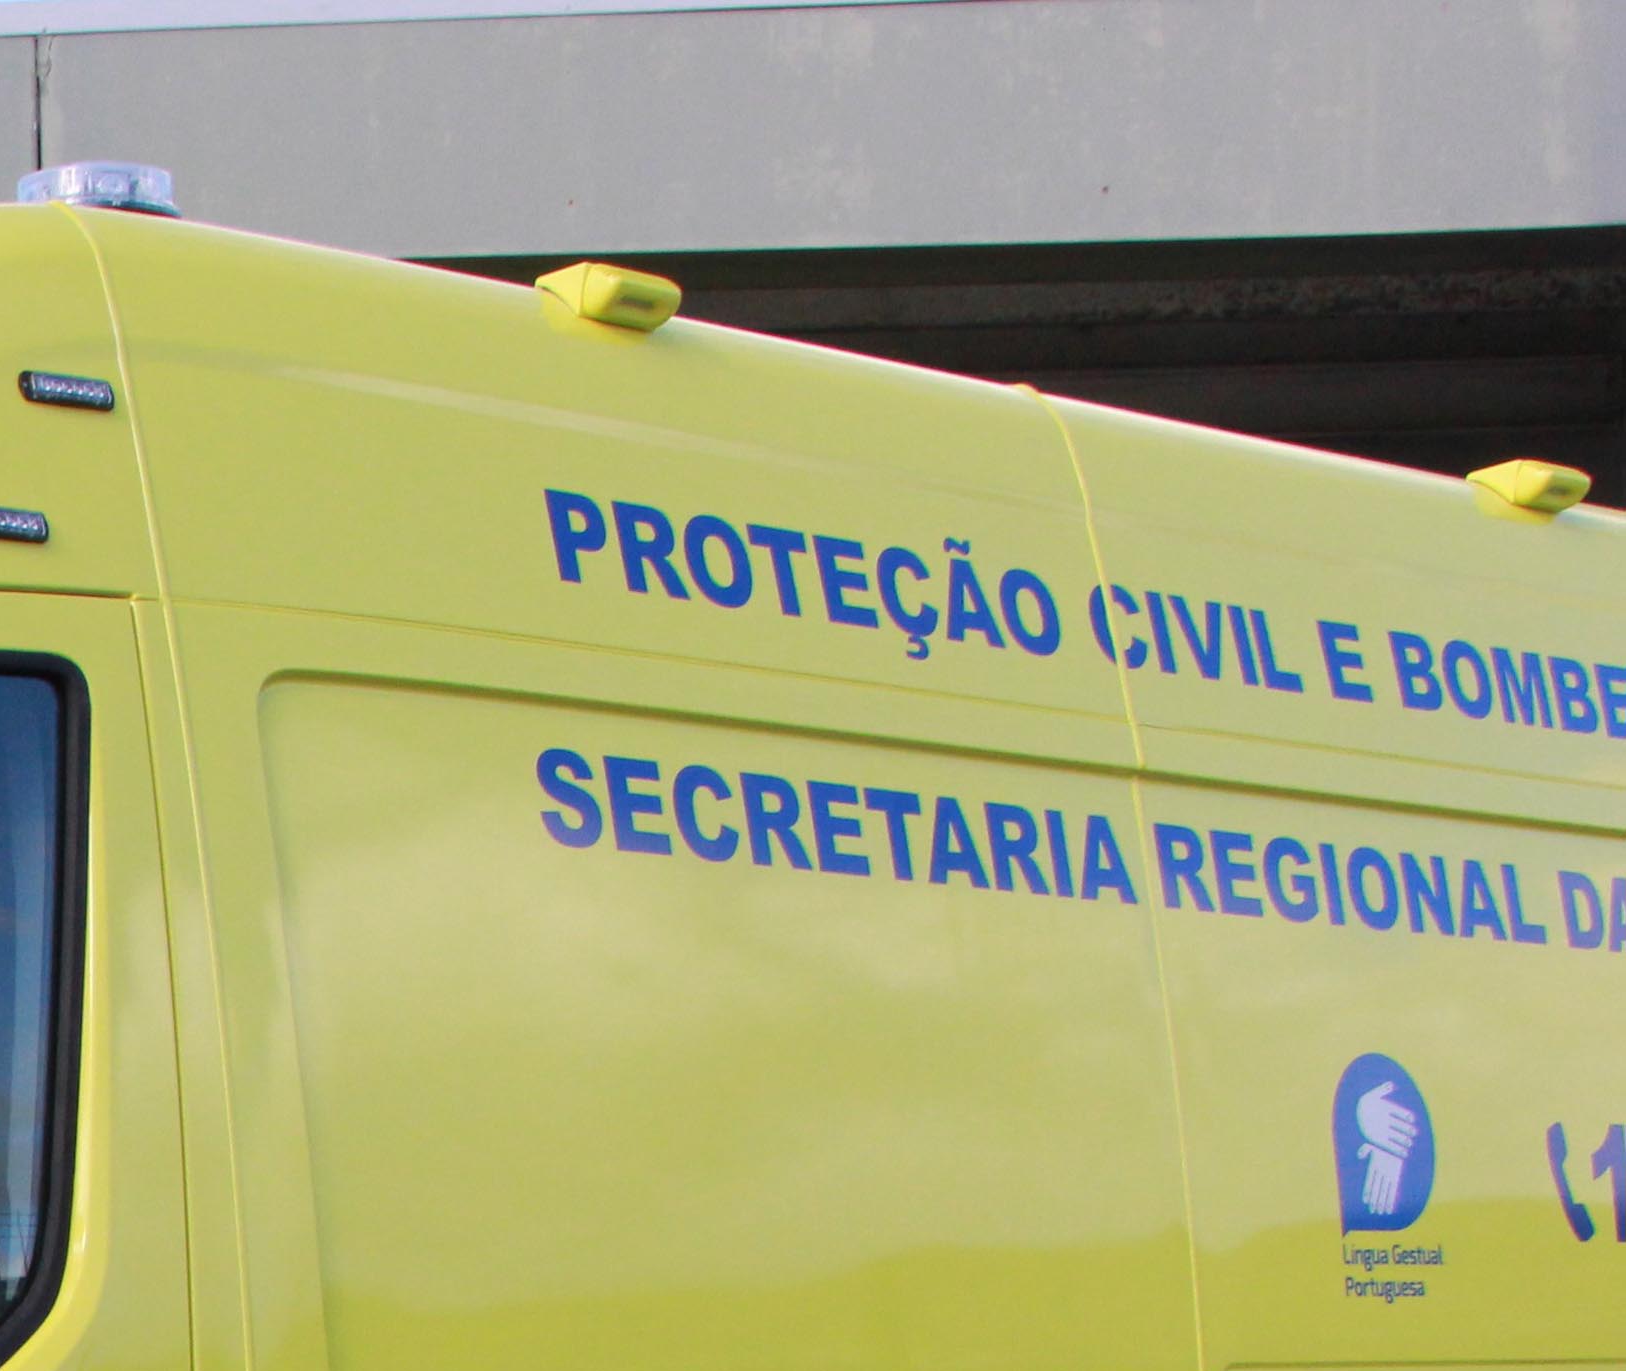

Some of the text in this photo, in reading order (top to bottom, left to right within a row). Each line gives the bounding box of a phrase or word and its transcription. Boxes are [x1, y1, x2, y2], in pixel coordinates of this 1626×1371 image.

[544, 488, 1061, 660] PROTEÇÃO
[1089, 584, 1304, 693] CIVIL
[1317, 620, 1374, 703] E
[536, 747, 1139, 904] SECRETARIA
[1153, 822, 1548, 945] REGIONAL
[1345, 1276, 1426, 1304] Portuguesa
[1392, 1244, 1444, 1265] Gestual
